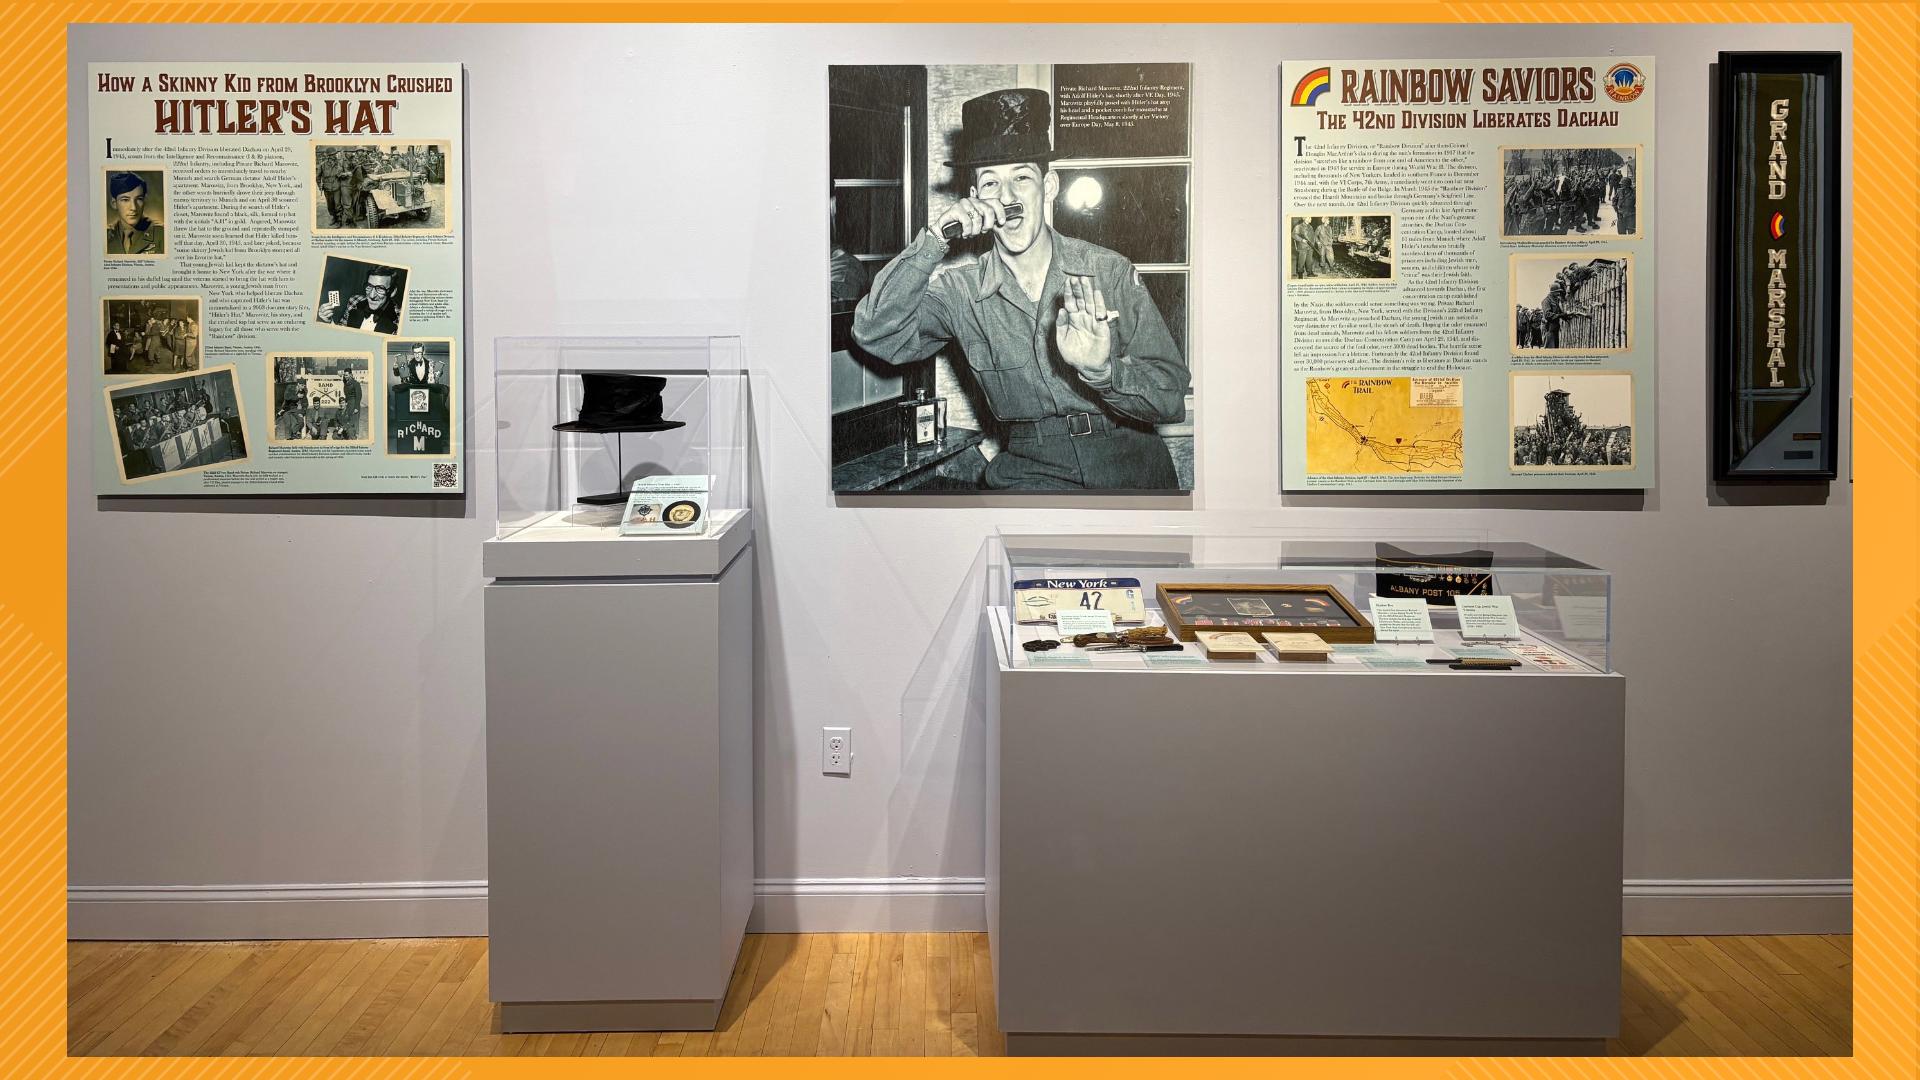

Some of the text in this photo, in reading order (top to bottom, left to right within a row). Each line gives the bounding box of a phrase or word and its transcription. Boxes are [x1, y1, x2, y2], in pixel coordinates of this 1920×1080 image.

[98, 73, 453, 93] HOW A SKINNY KID FROM BROOKLYN CRUSHED
[1341, 67, 1596, 106] RAINBOW SAVIORS
[1606, 88, 1644, 101] RAINBOW
[154, 99, 398, 135] HITLER'S HAT
[1316, 109, 1619, 130] THE 42ND DIVISION LIBERATES DACHAU
[1768, 98, 1790, 200] GRAND
[1766, 249, 1787, 387] MARSHAL
[398, 421, 441, 438] RICHARD
[414, 436, 425, 451] M
[1047, 579, 1108, 588] New York
[1390, 585, 1420, 594] ALBANY
[1080, 591, 1104, 610] 42
